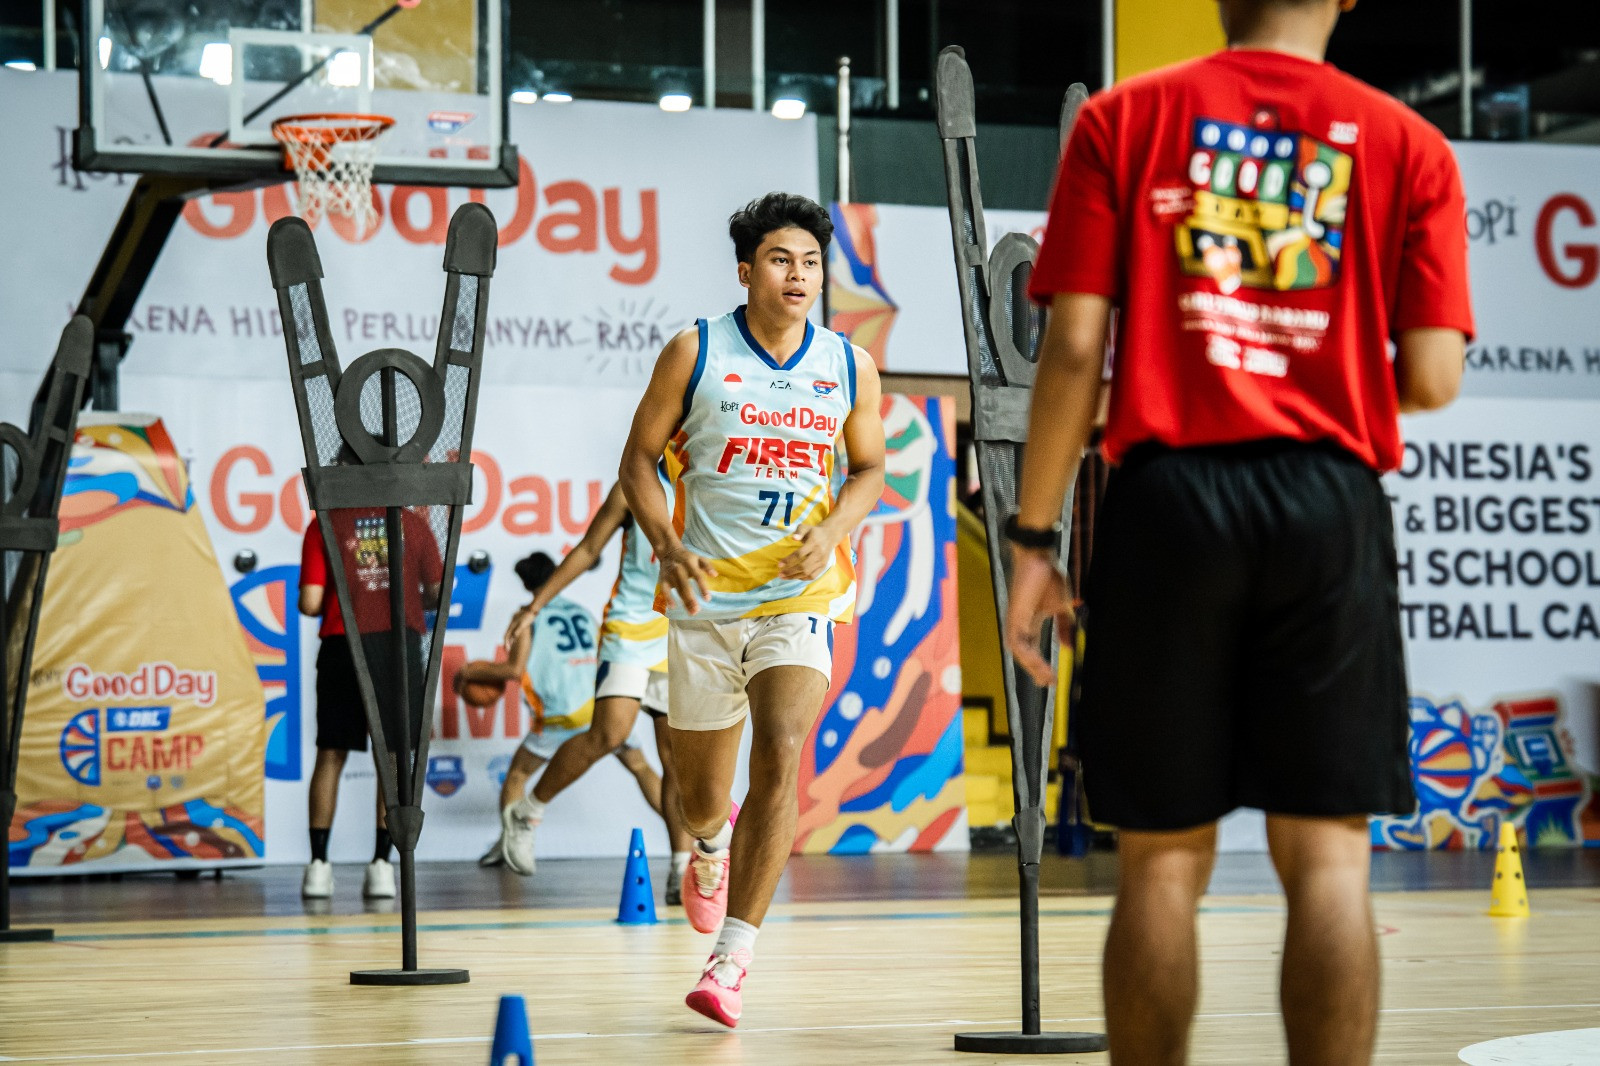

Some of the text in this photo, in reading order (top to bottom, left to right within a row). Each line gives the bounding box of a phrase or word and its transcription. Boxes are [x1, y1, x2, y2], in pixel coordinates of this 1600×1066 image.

[343, 309, 437, 342] PERLU
[598, 320, 664, 350] RASA
[716, 437, 832, 477] FIRST
[754, 466, 798, 479] TERM
[1399, 441, 1593, 482] ONESIA'S
[758, 490, 795, 526] 71
[1404, 495, 1600, 534] & BIGGES
[547, 614, 593, 651] 36
[1400, 602, 1600, 640] TBALL CA
[107, 735, 205, 771] CAMP
